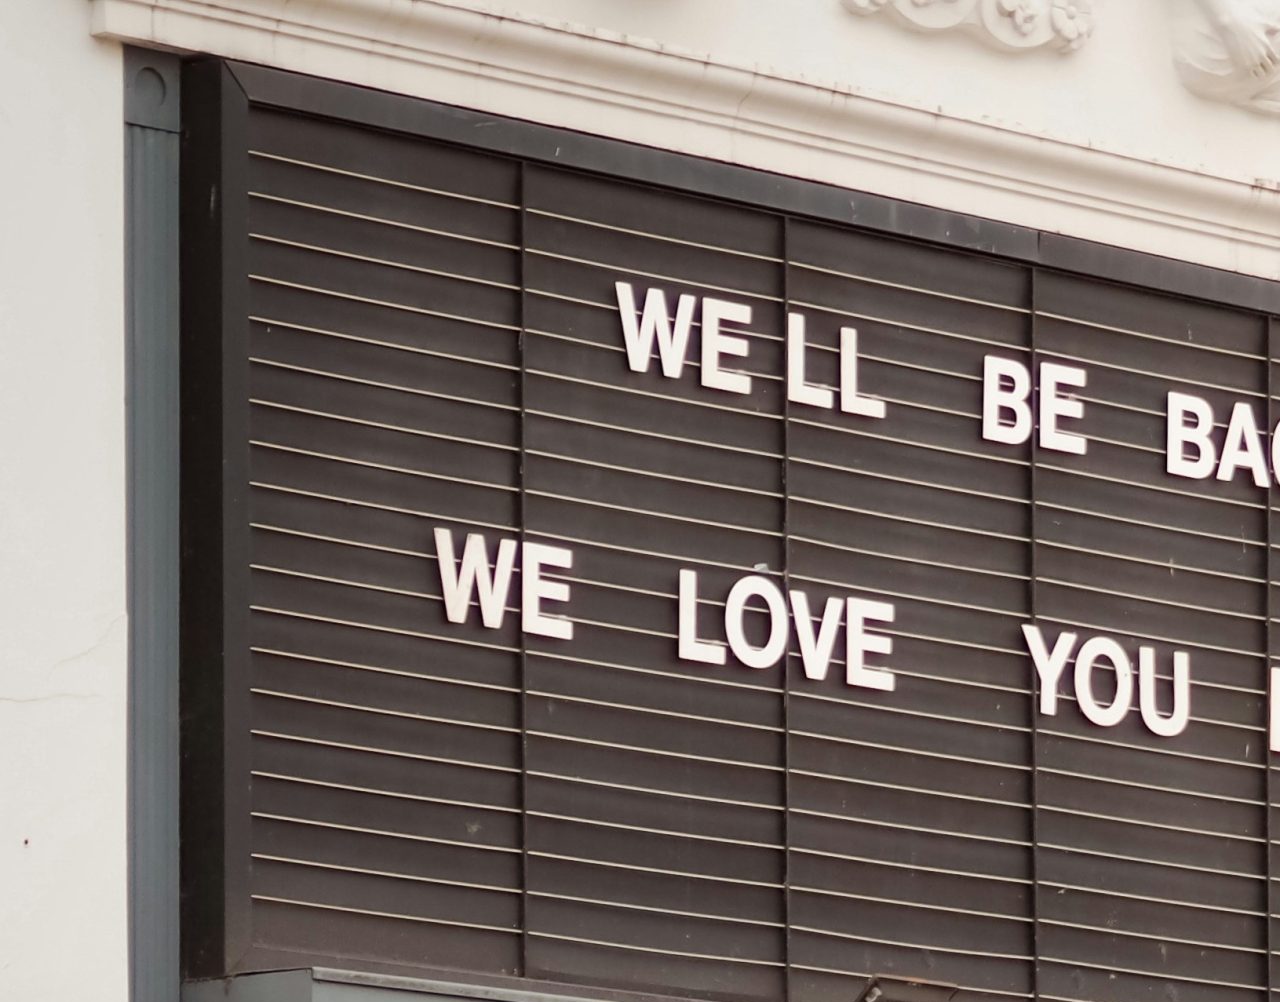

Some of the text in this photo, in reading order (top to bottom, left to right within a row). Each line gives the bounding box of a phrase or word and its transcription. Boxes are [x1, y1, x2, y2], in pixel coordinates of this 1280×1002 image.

[982, 355, 1089, 457] BE
[434, 527, 574, 640] WE
[677, 568, 897, 693] LOVE
[1021, 623, 1192, 738] YOU
